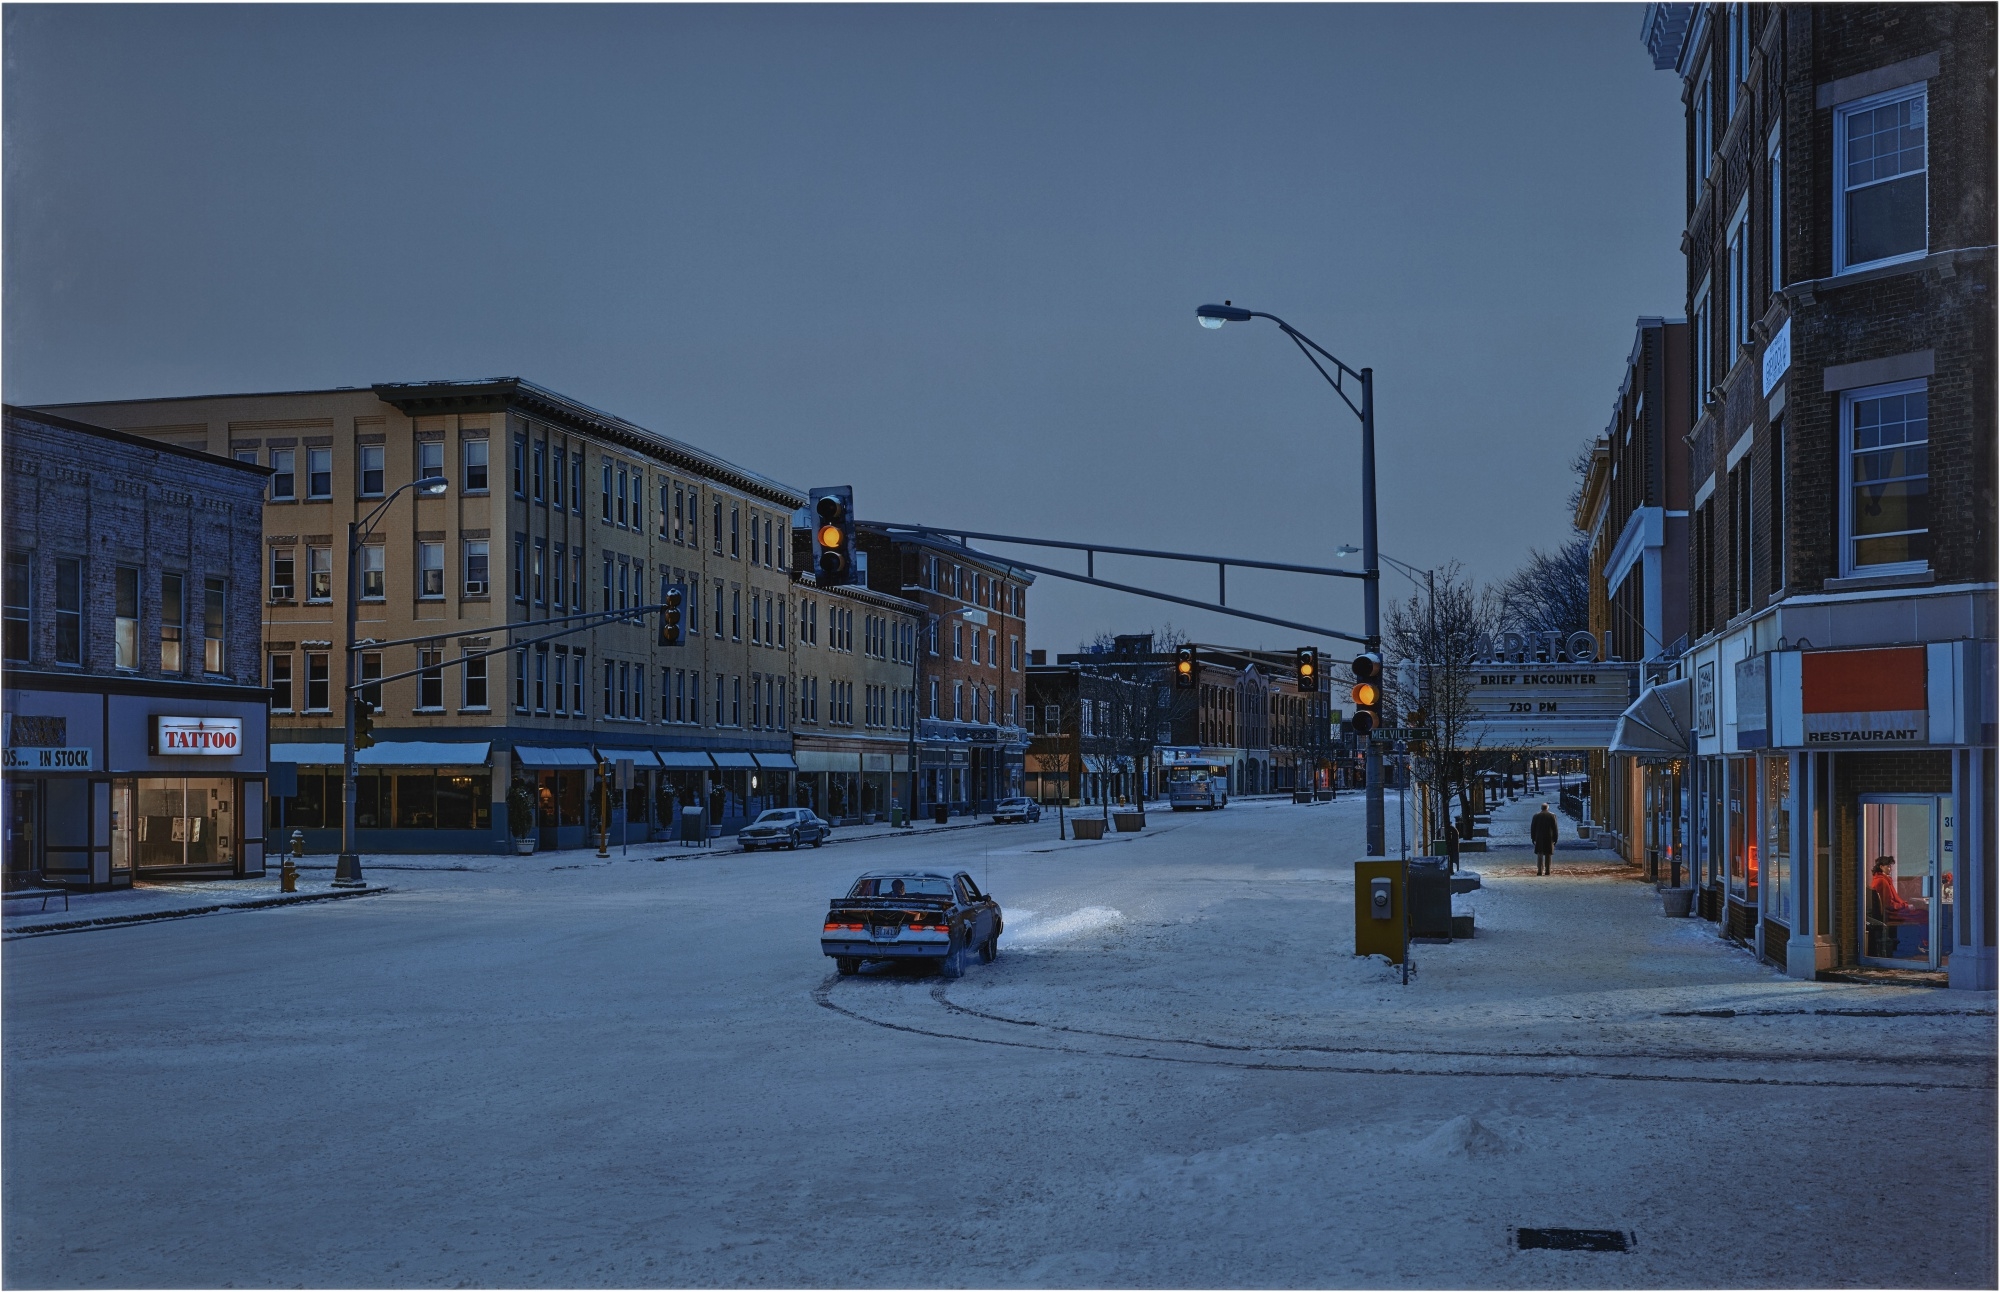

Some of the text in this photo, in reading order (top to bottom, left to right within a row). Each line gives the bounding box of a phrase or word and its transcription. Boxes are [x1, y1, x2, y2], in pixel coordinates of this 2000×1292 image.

[1481, 674, 1596, 685] BRIEF ENCOUNTER
[1509, 702, 1557, 712] 730 PM
[165, 731, 237, 748] TATTOO
[1371, 729, 1414, 739] MELVILLE
[1808, 729, 1918, 742] RESTAURANT
[39, 750, 52, 767] IN
[54, 750, 89, 767] STOCK
